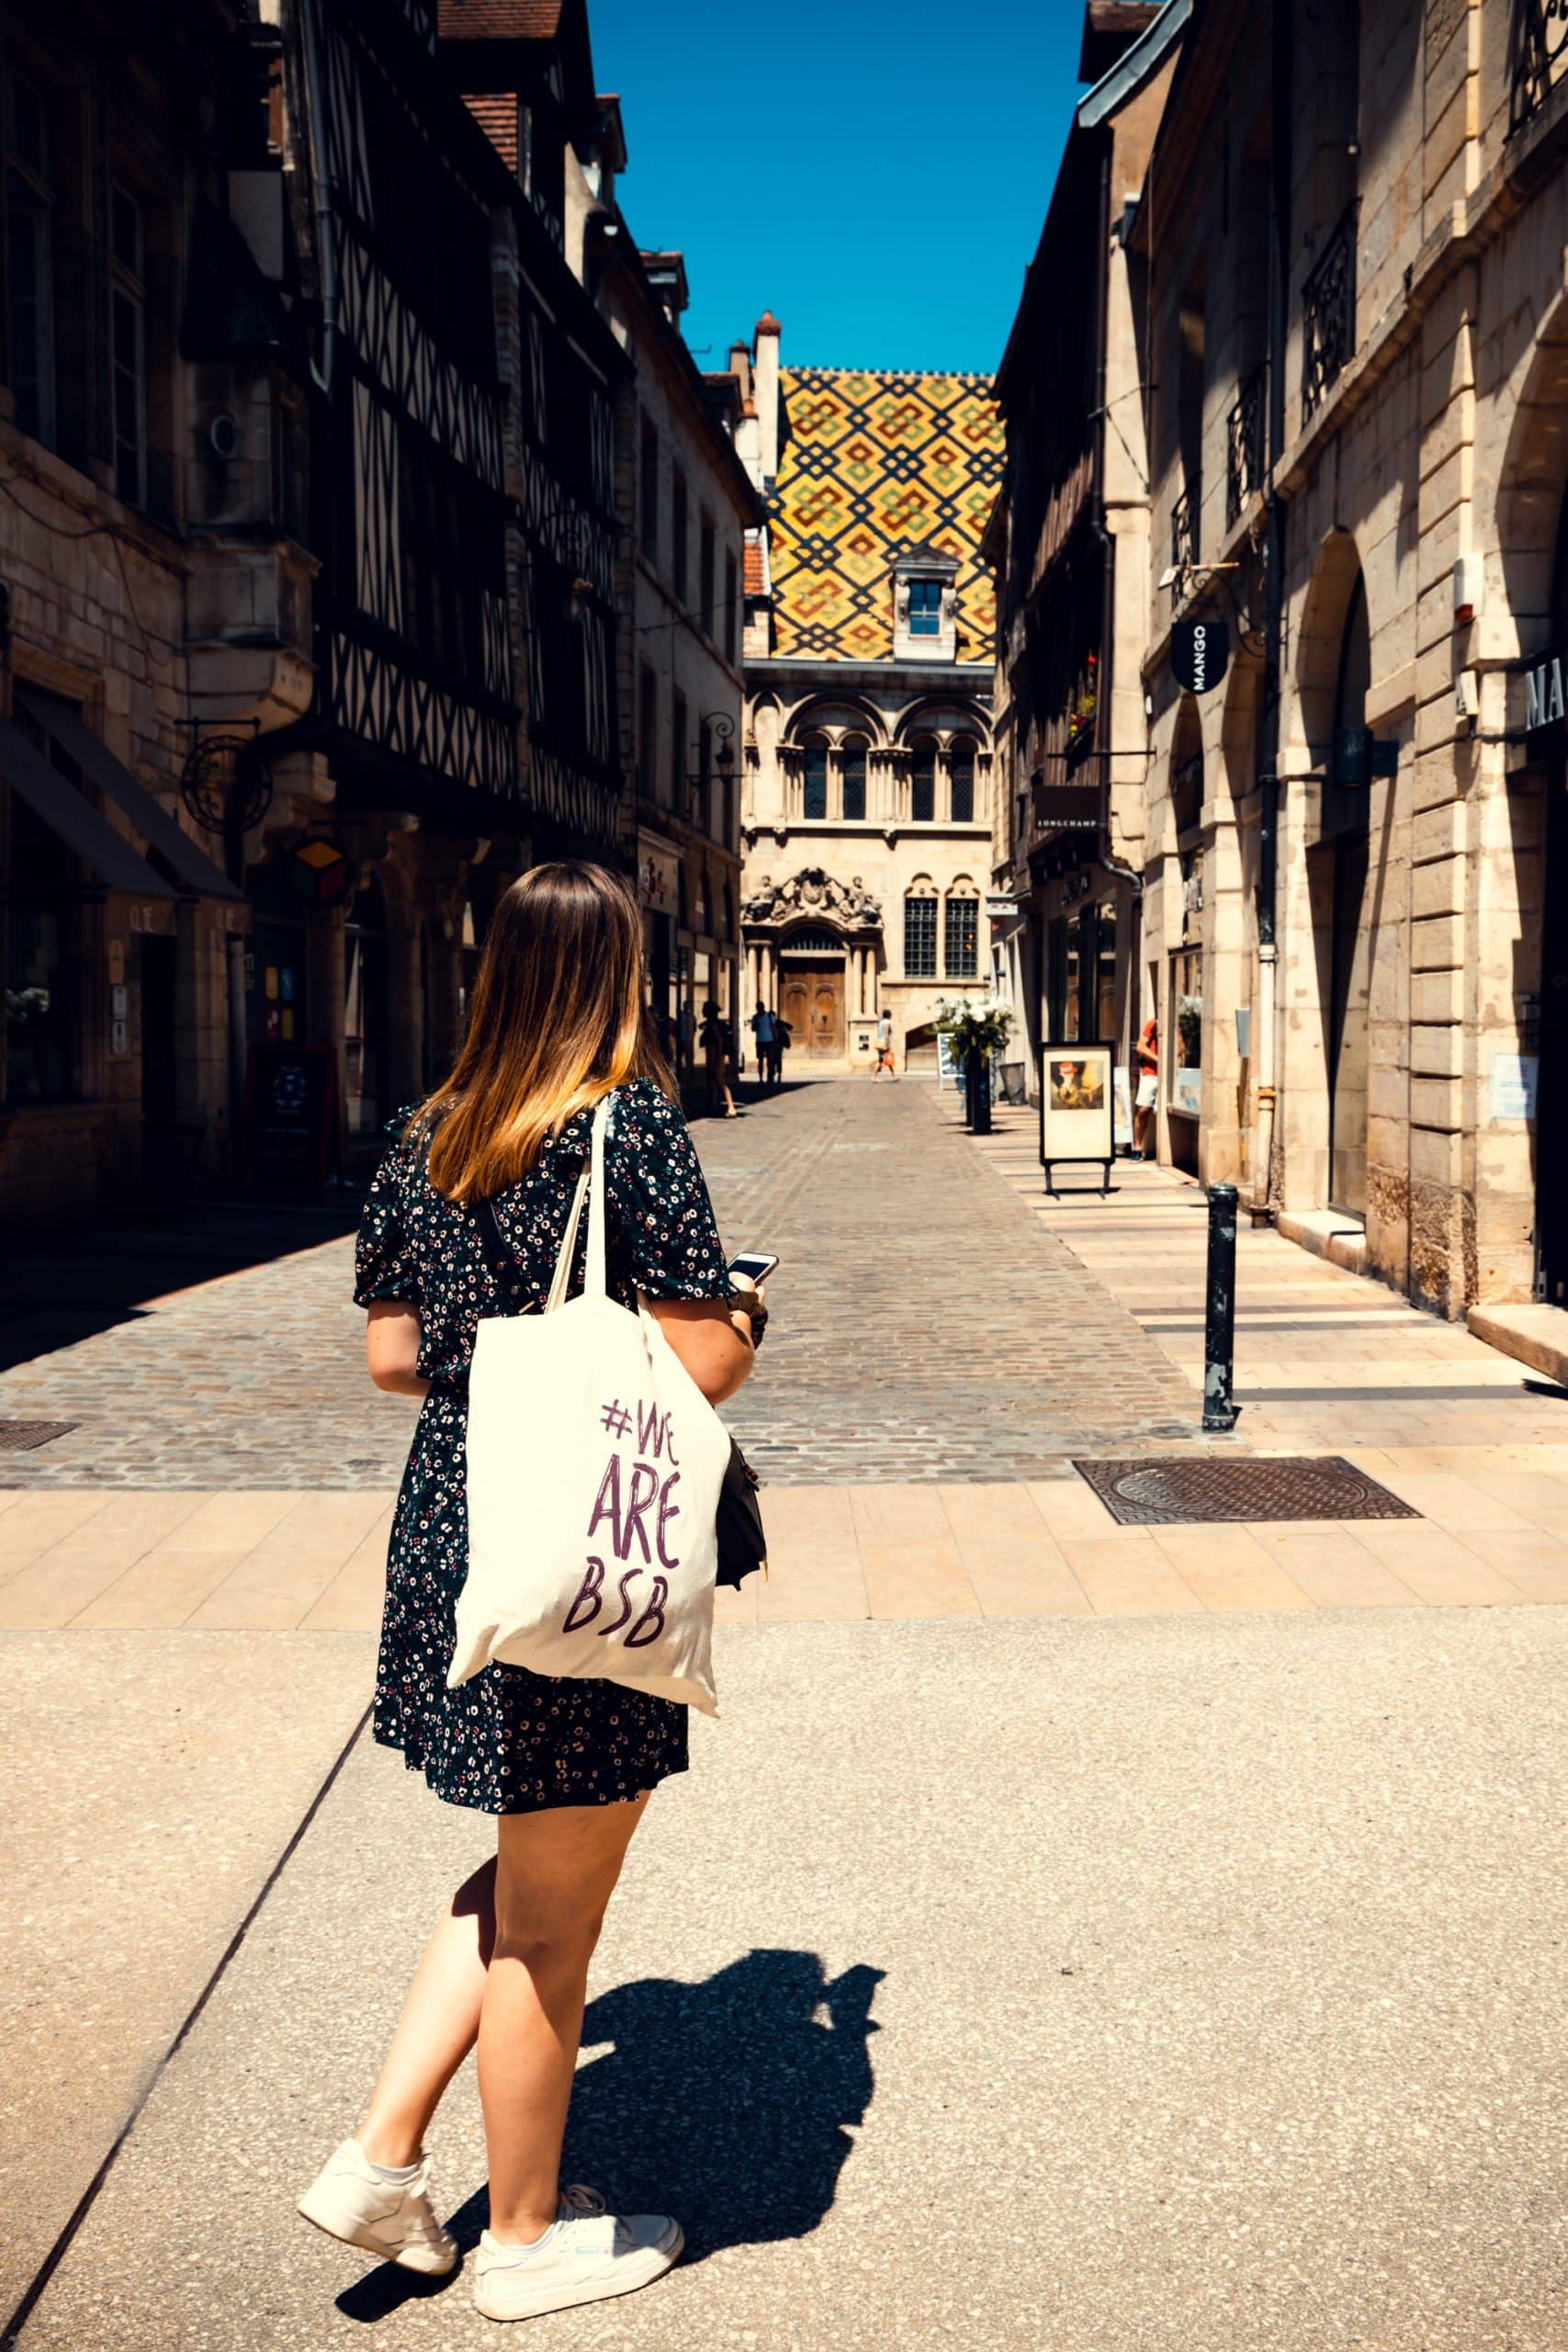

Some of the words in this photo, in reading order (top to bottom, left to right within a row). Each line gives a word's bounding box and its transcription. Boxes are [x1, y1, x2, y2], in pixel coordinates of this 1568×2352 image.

[1193, 625, 1206, 691] MANGO
[1525, 657, 1568, 731] MA
[600, 1398, 680, 1466] #WE
[586, 1453, 681, 1569] ARE
[562, 1555, 669, 1647] BSB
